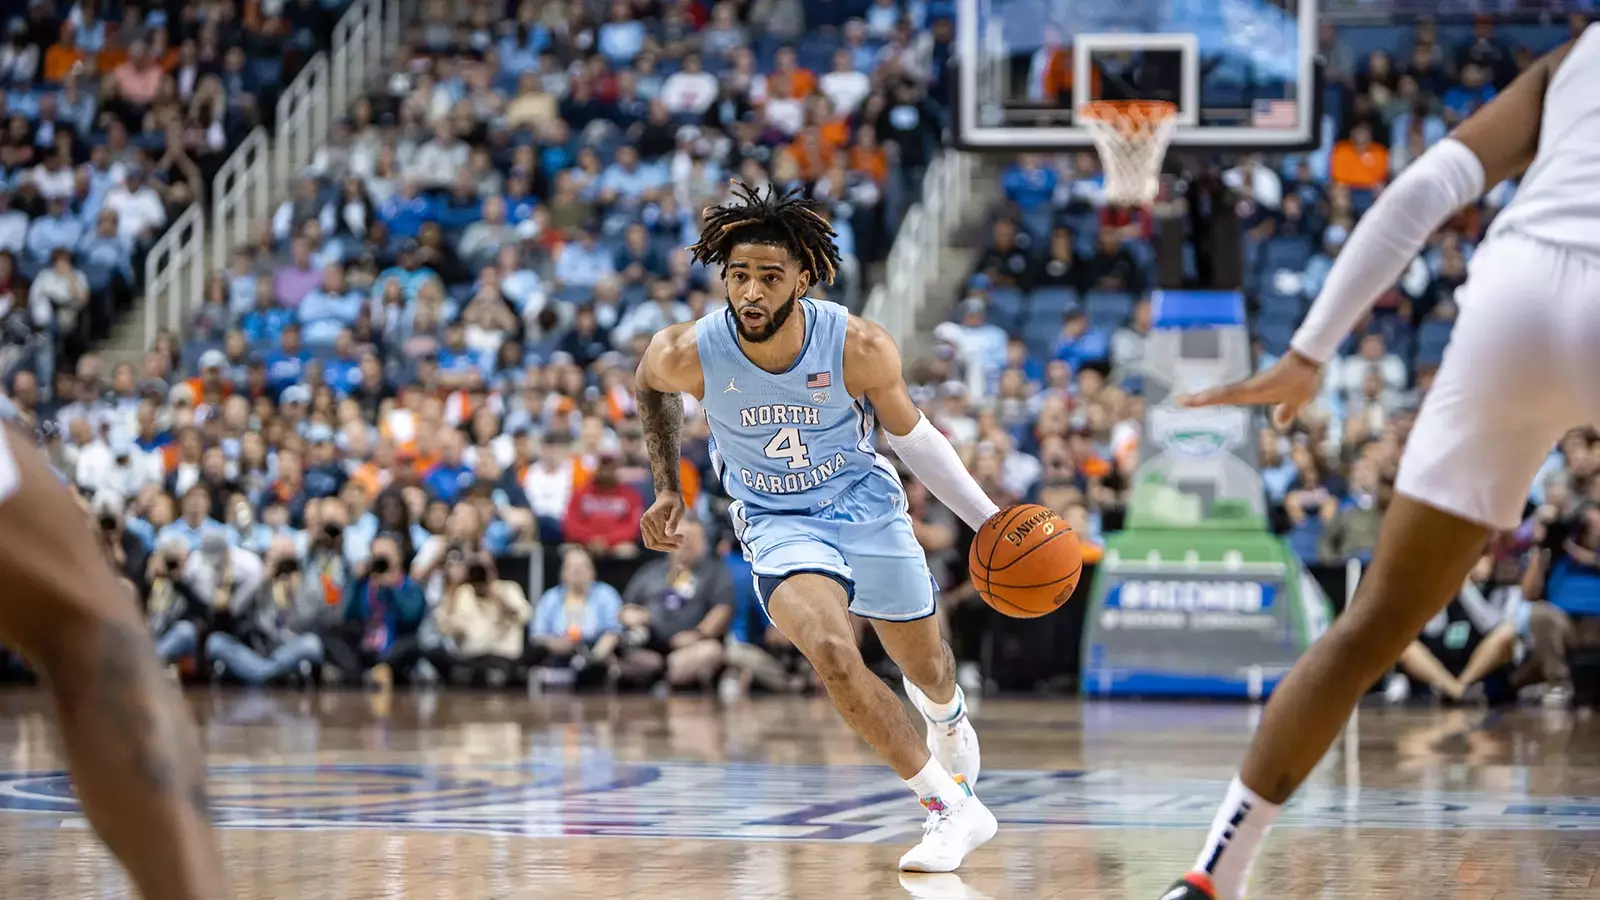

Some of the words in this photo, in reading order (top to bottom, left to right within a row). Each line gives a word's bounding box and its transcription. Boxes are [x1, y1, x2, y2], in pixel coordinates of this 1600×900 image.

[740, 404, 820, 427] NORTH
[763, 427, 811, 470] 4
[740, 452, 846, 494] CAROLINA
[1003, 508, 1057, 547] PALDING
